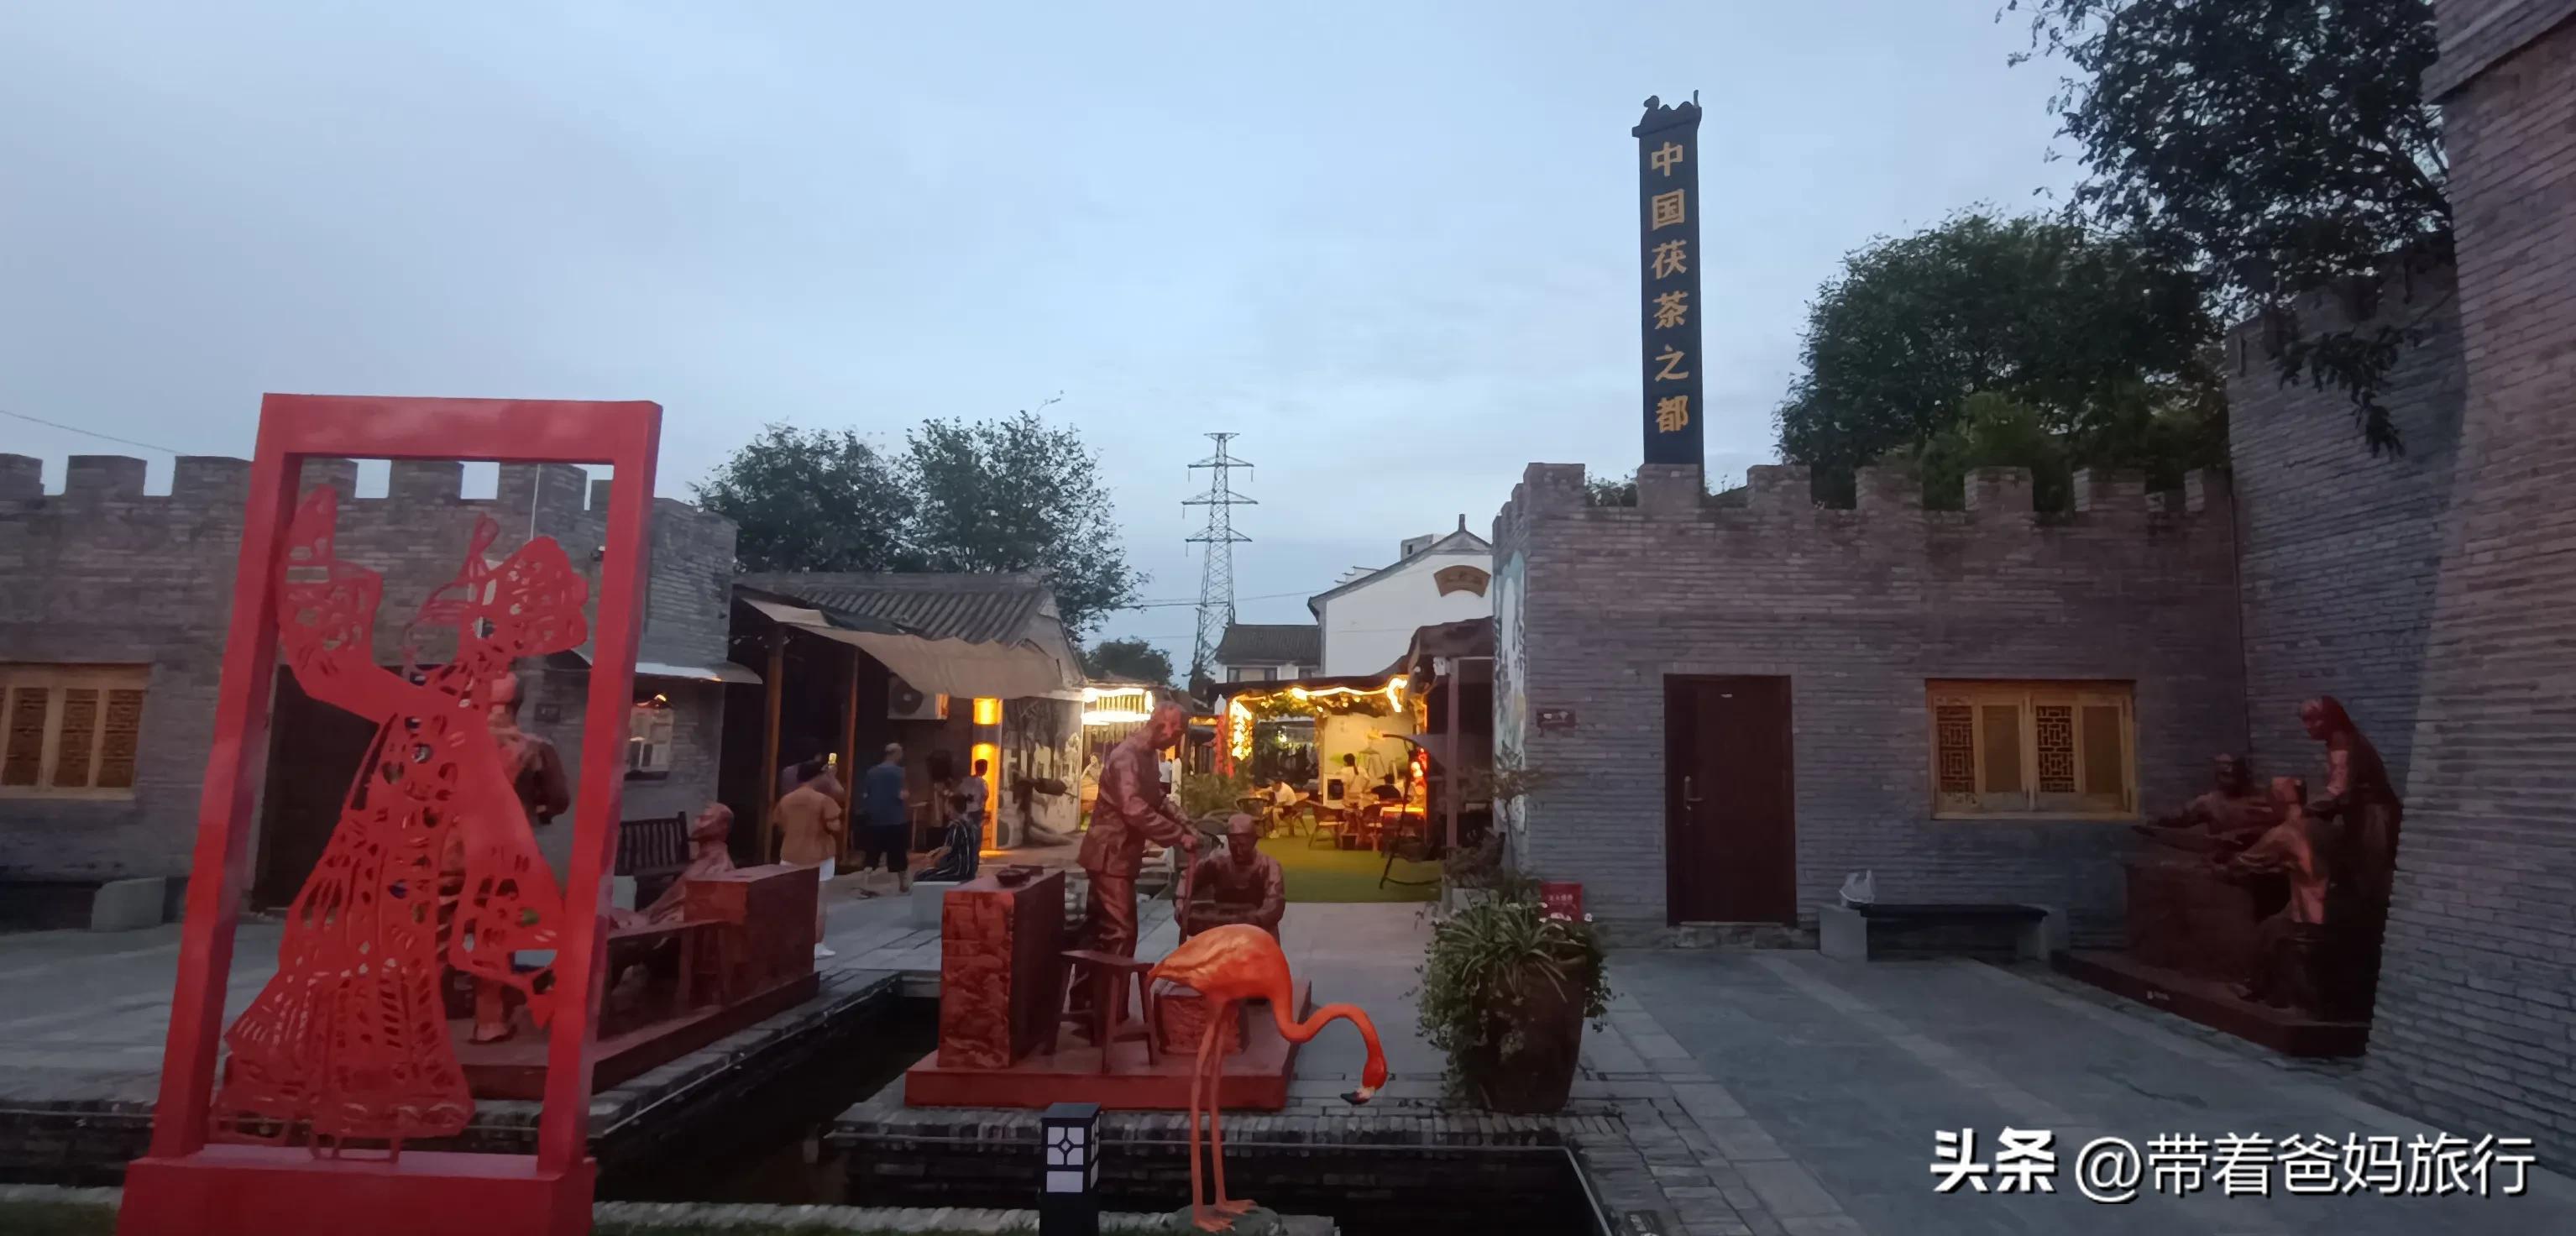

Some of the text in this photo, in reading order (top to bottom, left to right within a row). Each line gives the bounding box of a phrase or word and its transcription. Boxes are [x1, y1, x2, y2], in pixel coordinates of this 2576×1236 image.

[1651, 141, 1690, 434] 中国茯茶之都
